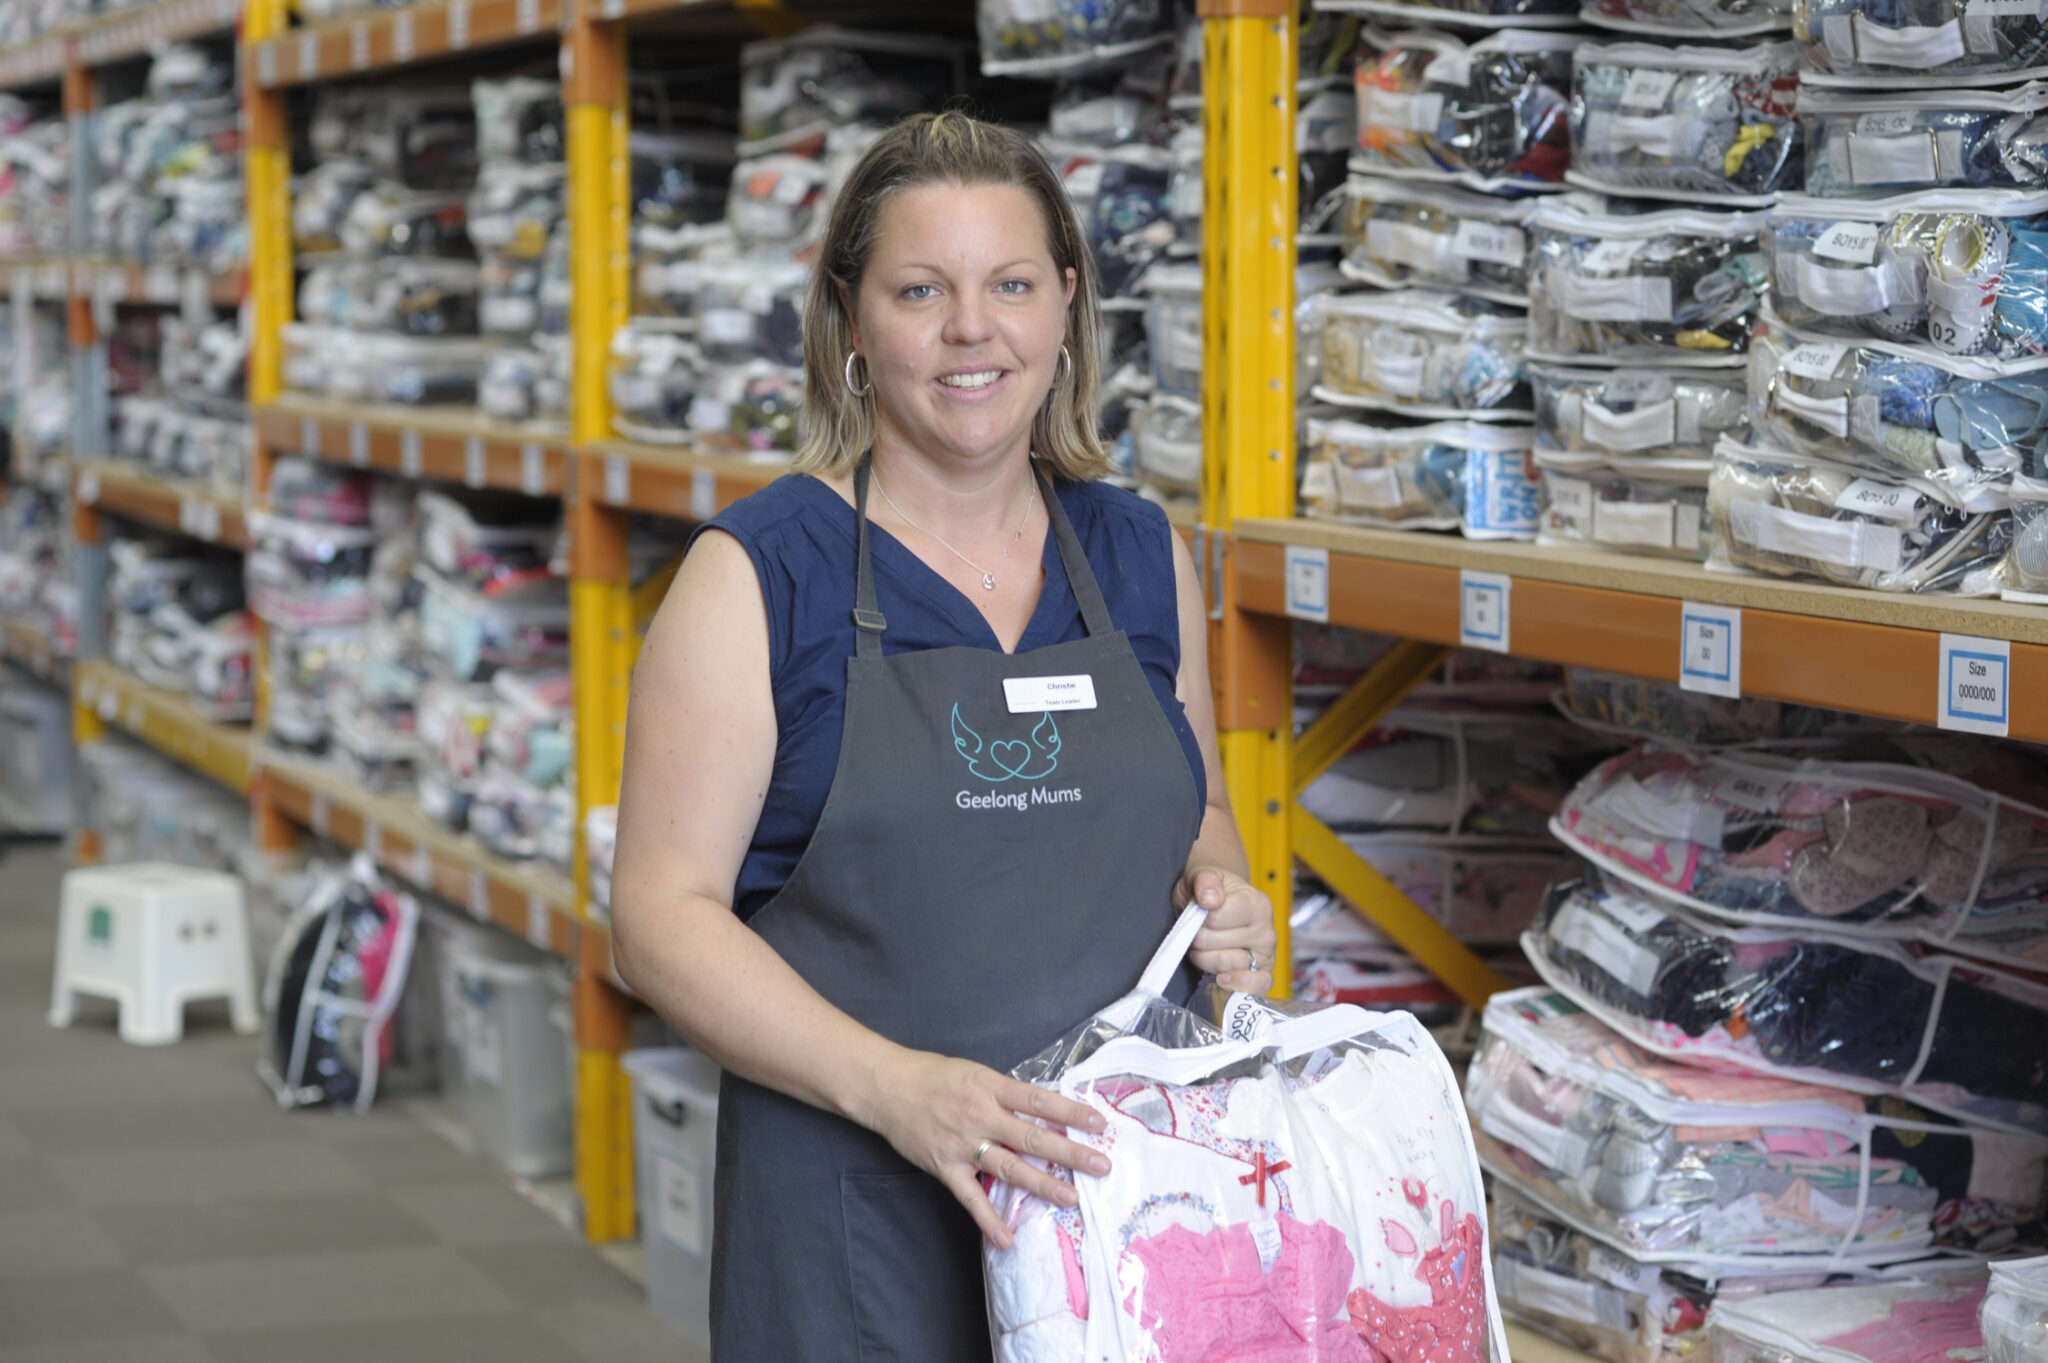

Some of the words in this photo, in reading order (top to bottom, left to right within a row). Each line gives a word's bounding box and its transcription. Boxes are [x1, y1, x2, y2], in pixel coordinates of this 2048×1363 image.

[1832, 232, 1858, 250] BOYS
[1933, 321, 1956, 347] 02
[1969, 661, 1987, 676] Size
[1959, 683, 1996, 702] 0000/000
[955, 789, 1028, 811] Geelong
[1031, 786, 1082, 805] Mums
